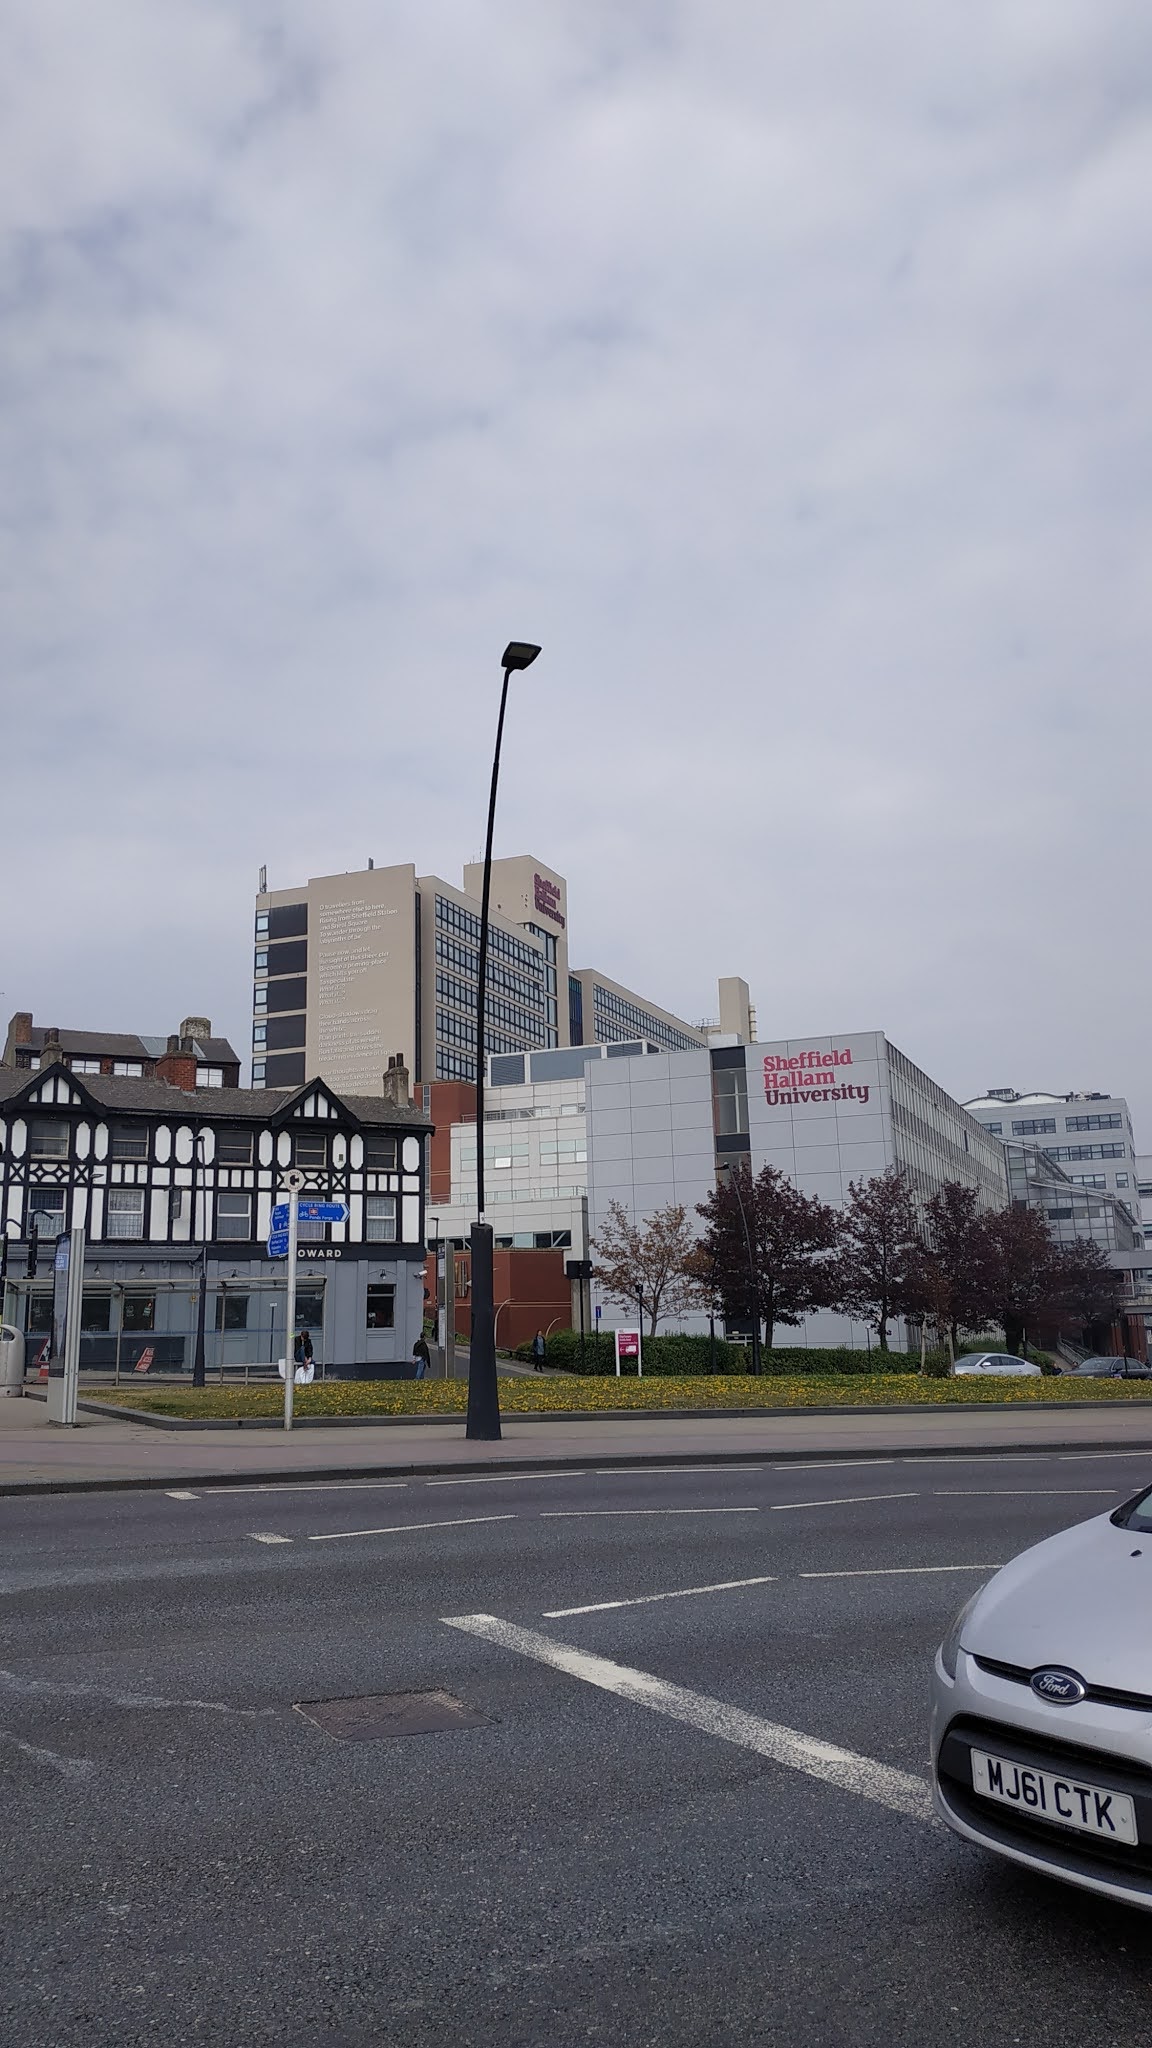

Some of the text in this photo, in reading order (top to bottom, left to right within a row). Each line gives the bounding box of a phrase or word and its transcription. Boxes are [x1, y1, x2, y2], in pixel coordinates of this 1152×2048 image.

[763, 1048, 853, 1072] Sheffield
[763, 1070, 836, 1089] Hallam
[764, 1083, 870, 1106] University
[297, 1249, 342, 1258] OWARD
[1039, 1674, 1070, 1696] Ford
[987, 1758, 1047, 1811] MJ61
[1054, 1781, 1116, 1832] CTK
